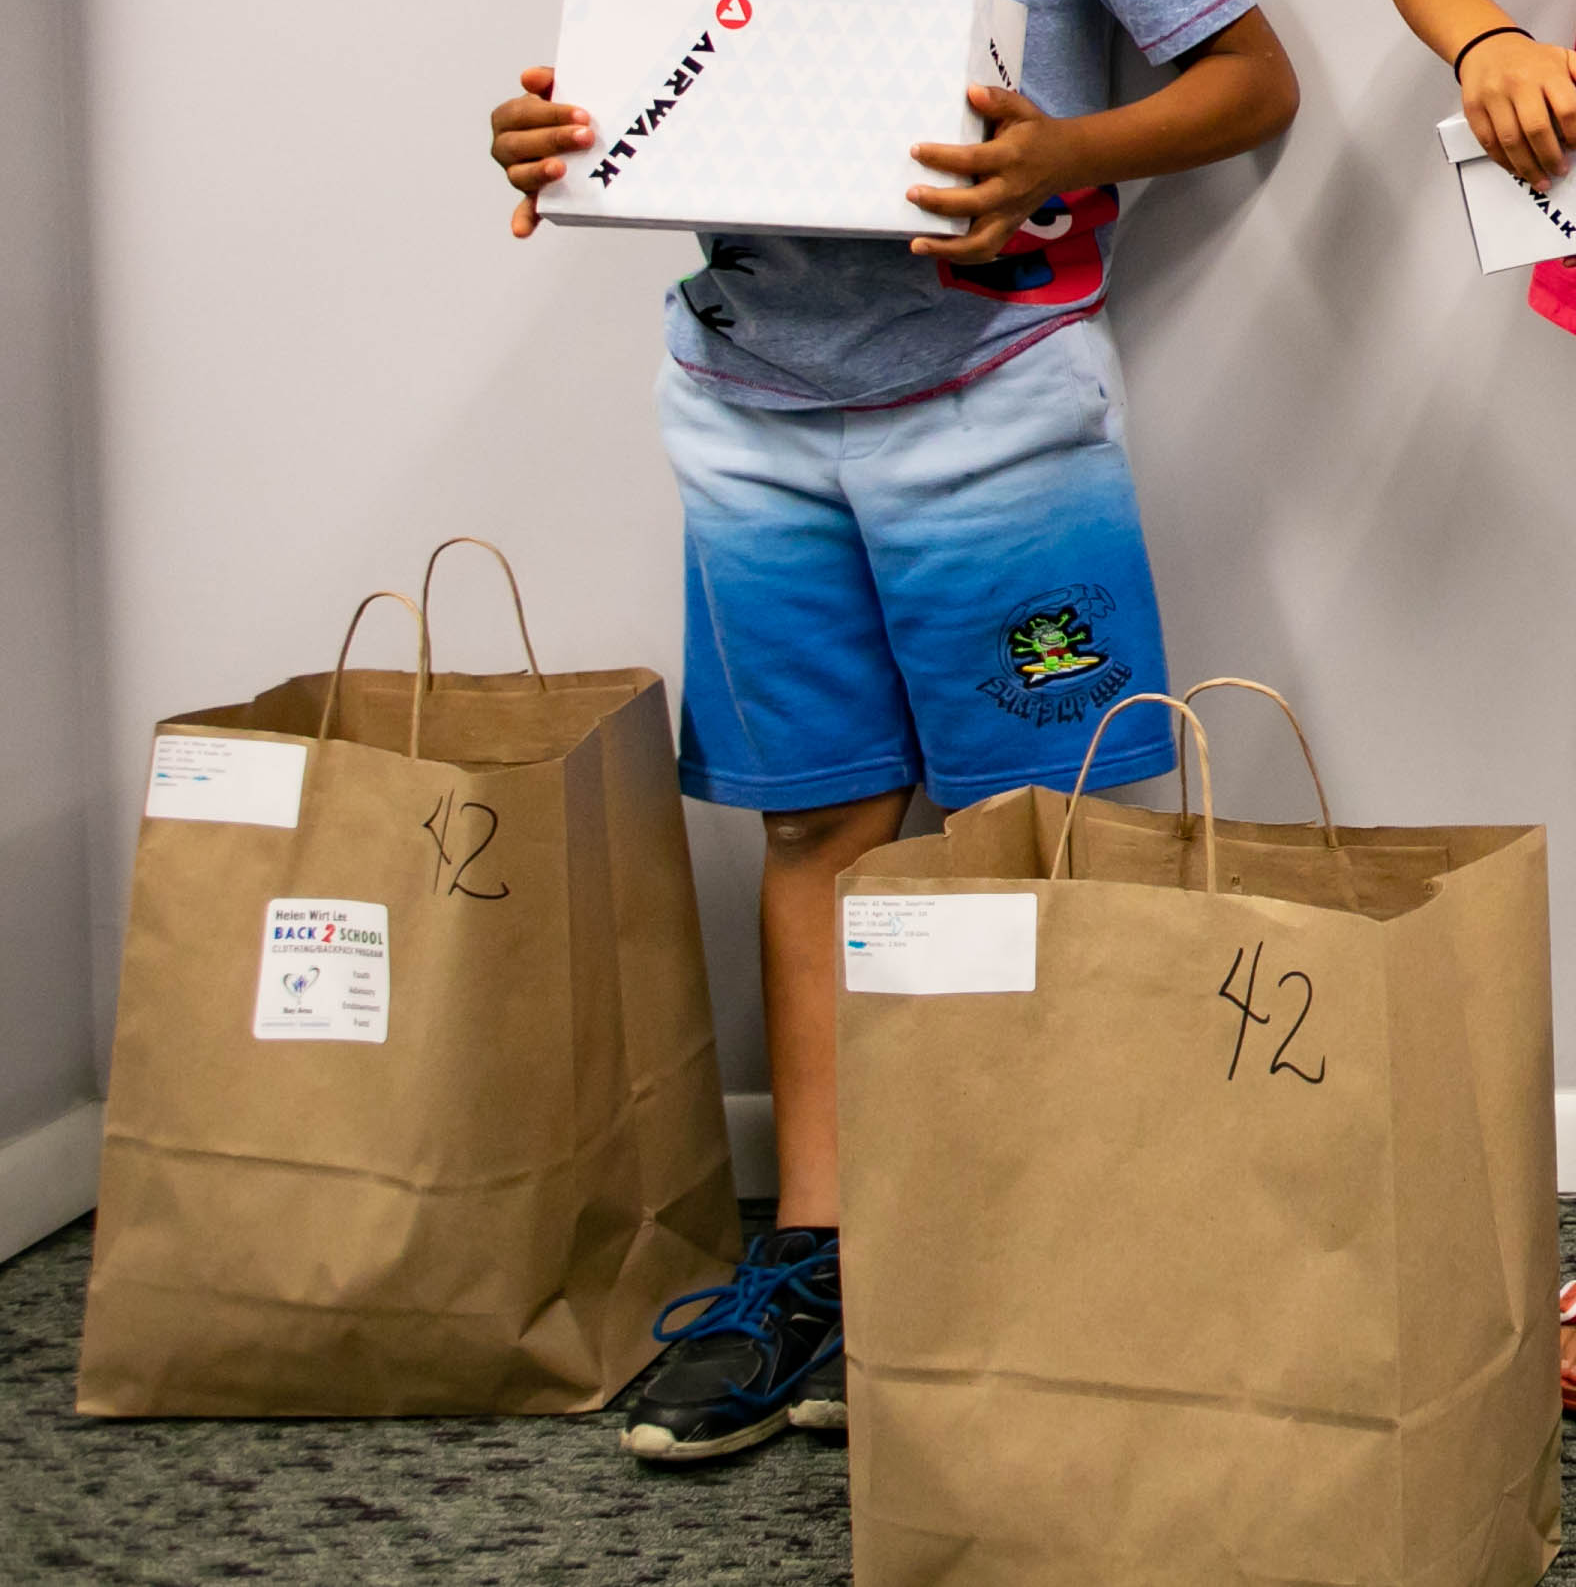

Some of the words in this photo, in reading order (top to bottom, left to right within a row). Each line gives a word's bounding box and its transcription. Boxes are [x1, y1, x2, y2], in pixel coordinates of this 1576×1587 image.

[588, 30, 716, 189] AIRWALK
[422, 789, 511, 900] 42
[274, 927, 317, 940] BACK
[321, 924, 336, 943] 2
[340, 928, 383, 945] SCHOOL
[276, 910, 306, 921] Helen
[310, 910, 330, 920] Wirt
[333, 911, 347, 922] Lee
[1218, 941, 1326, 1084] 42
